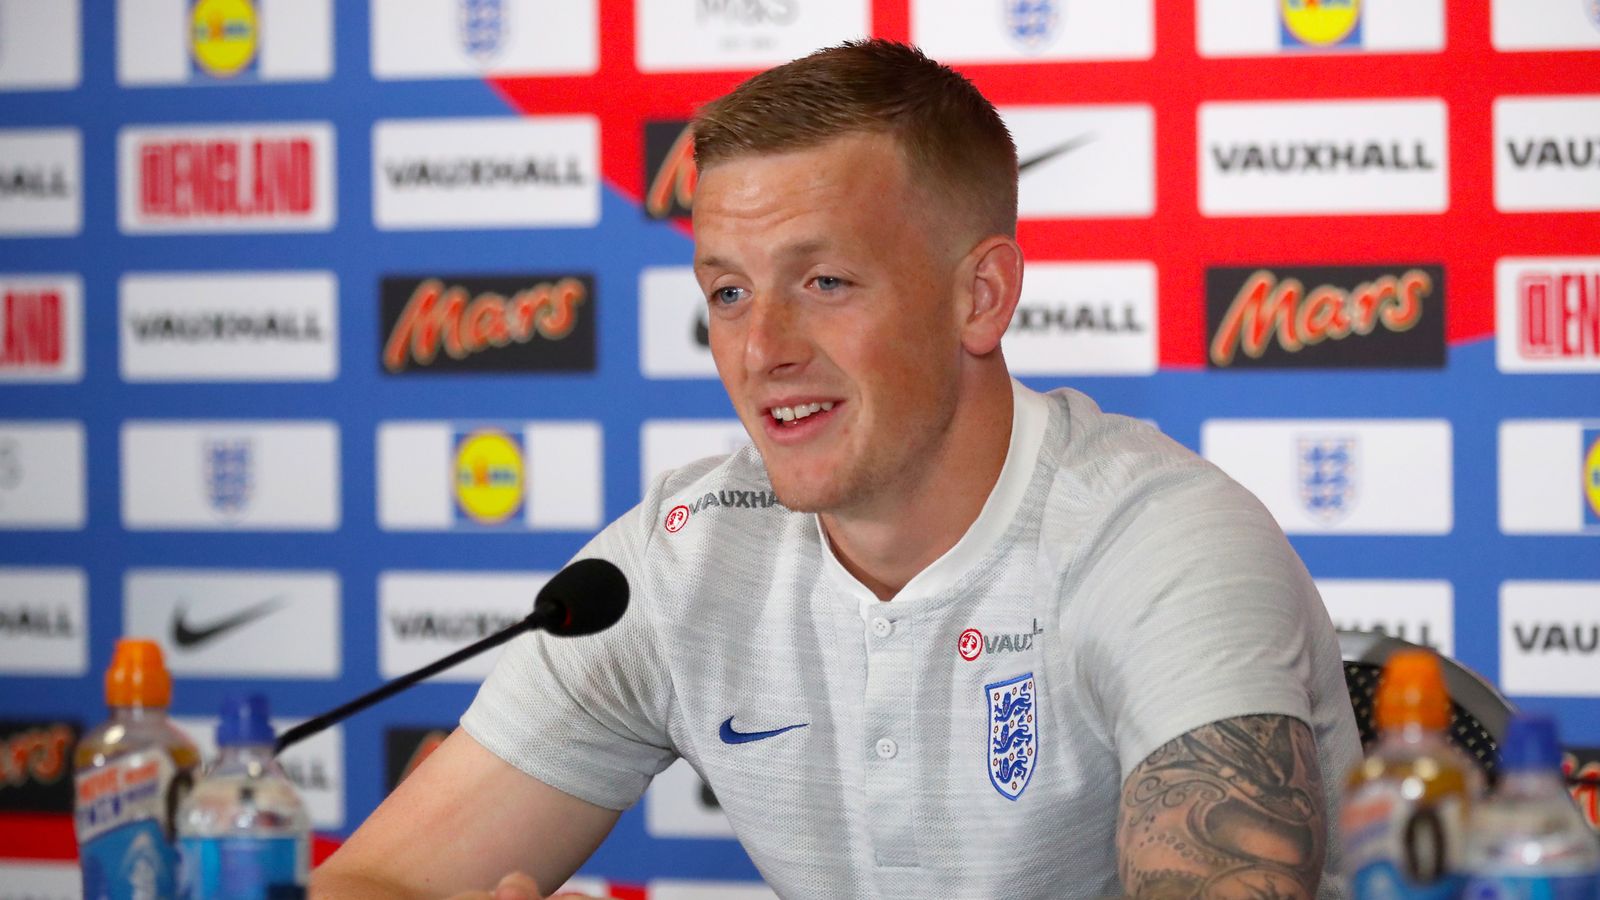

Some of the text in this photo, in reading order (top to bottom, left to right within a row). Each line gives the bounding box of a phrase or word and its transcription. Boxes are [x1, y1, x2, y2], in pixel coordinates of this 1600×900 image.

[1212, 142, 1436, 173] VAUXHALL
[1507, 139, 1600, 169] VAU
[0, 166, 69, 199] ALL
[385, 156, 588, 189] VAUXHALL
[132, 313, 322, 343] VAUXHALL
[384, 278, 583, 373] Mars
[1210, 270, 1431, 366] Mars
